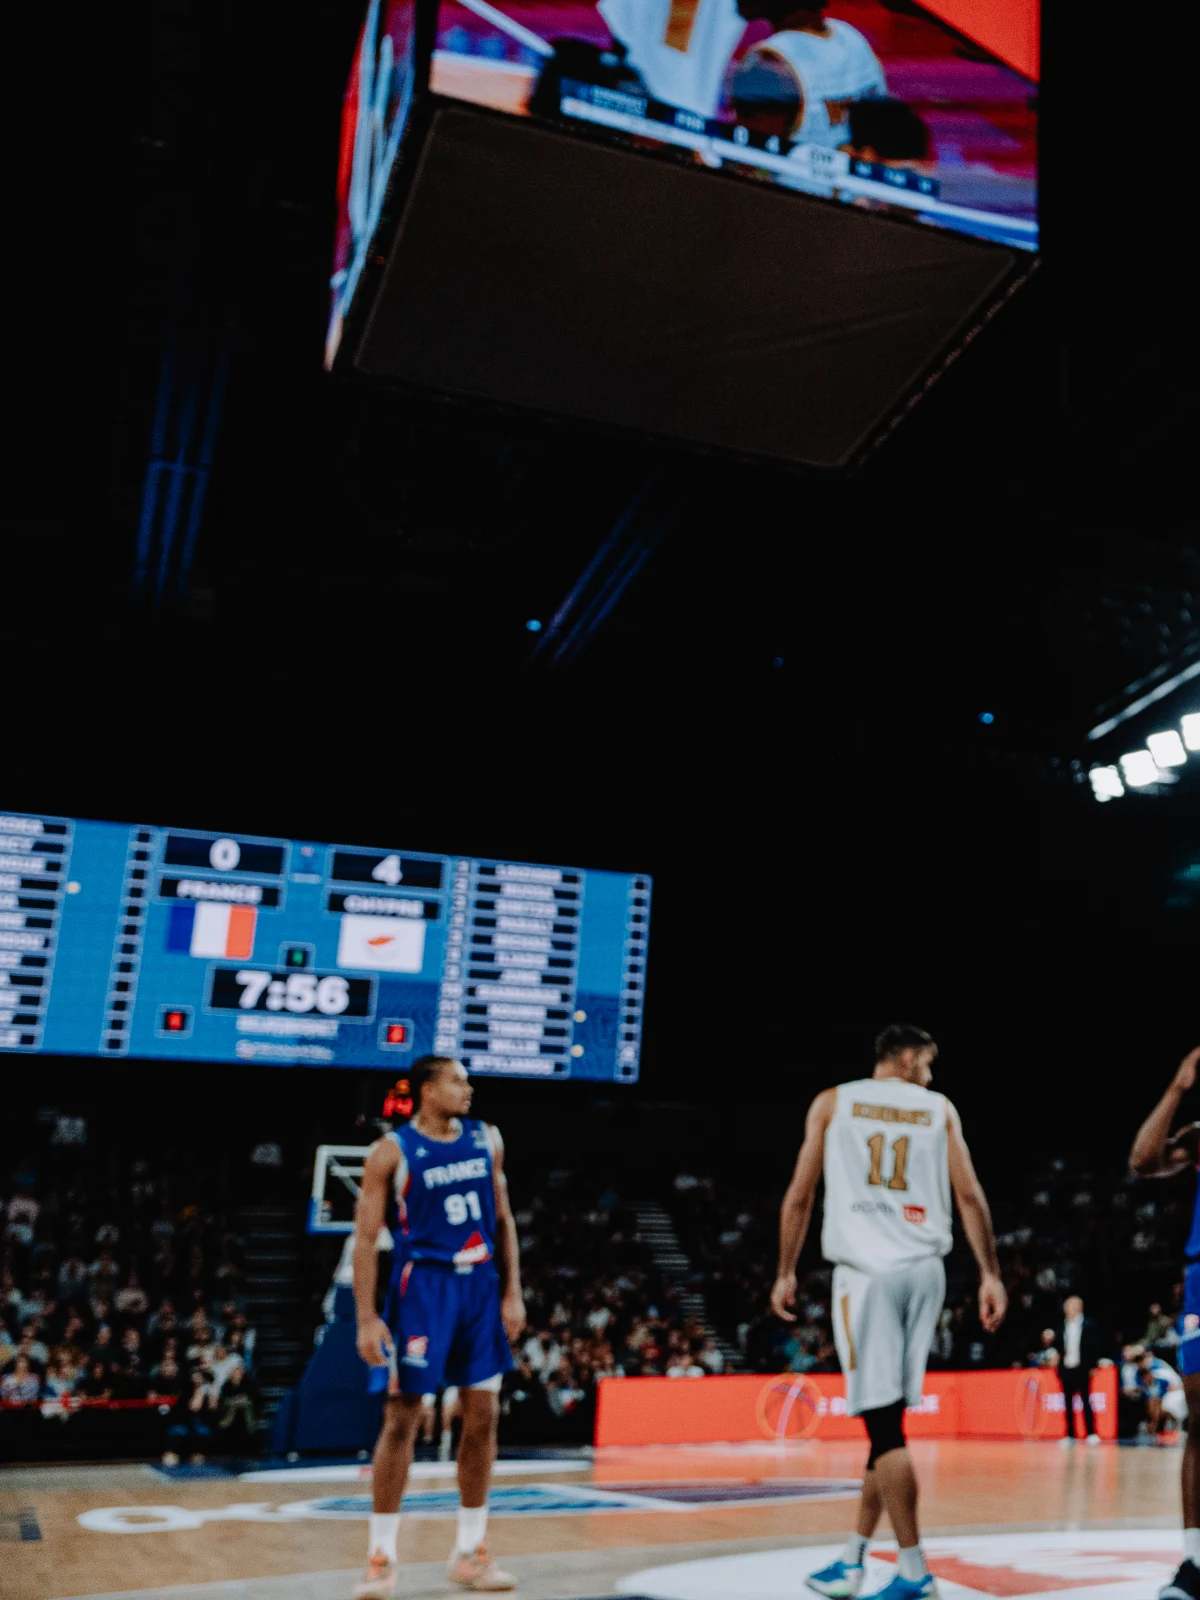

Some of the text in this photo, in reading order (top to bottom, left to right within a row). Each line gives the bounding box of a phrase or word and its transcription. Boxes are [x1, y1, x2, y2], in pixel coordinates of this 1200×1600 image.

[209, 838, 241, 872] 0
[371, 854, 404, 887] 4
[235, 969, 350, 1015] 7:56
[867, 1132, 910, 1191] 11
[444, 1190, 482, 1226] 91
